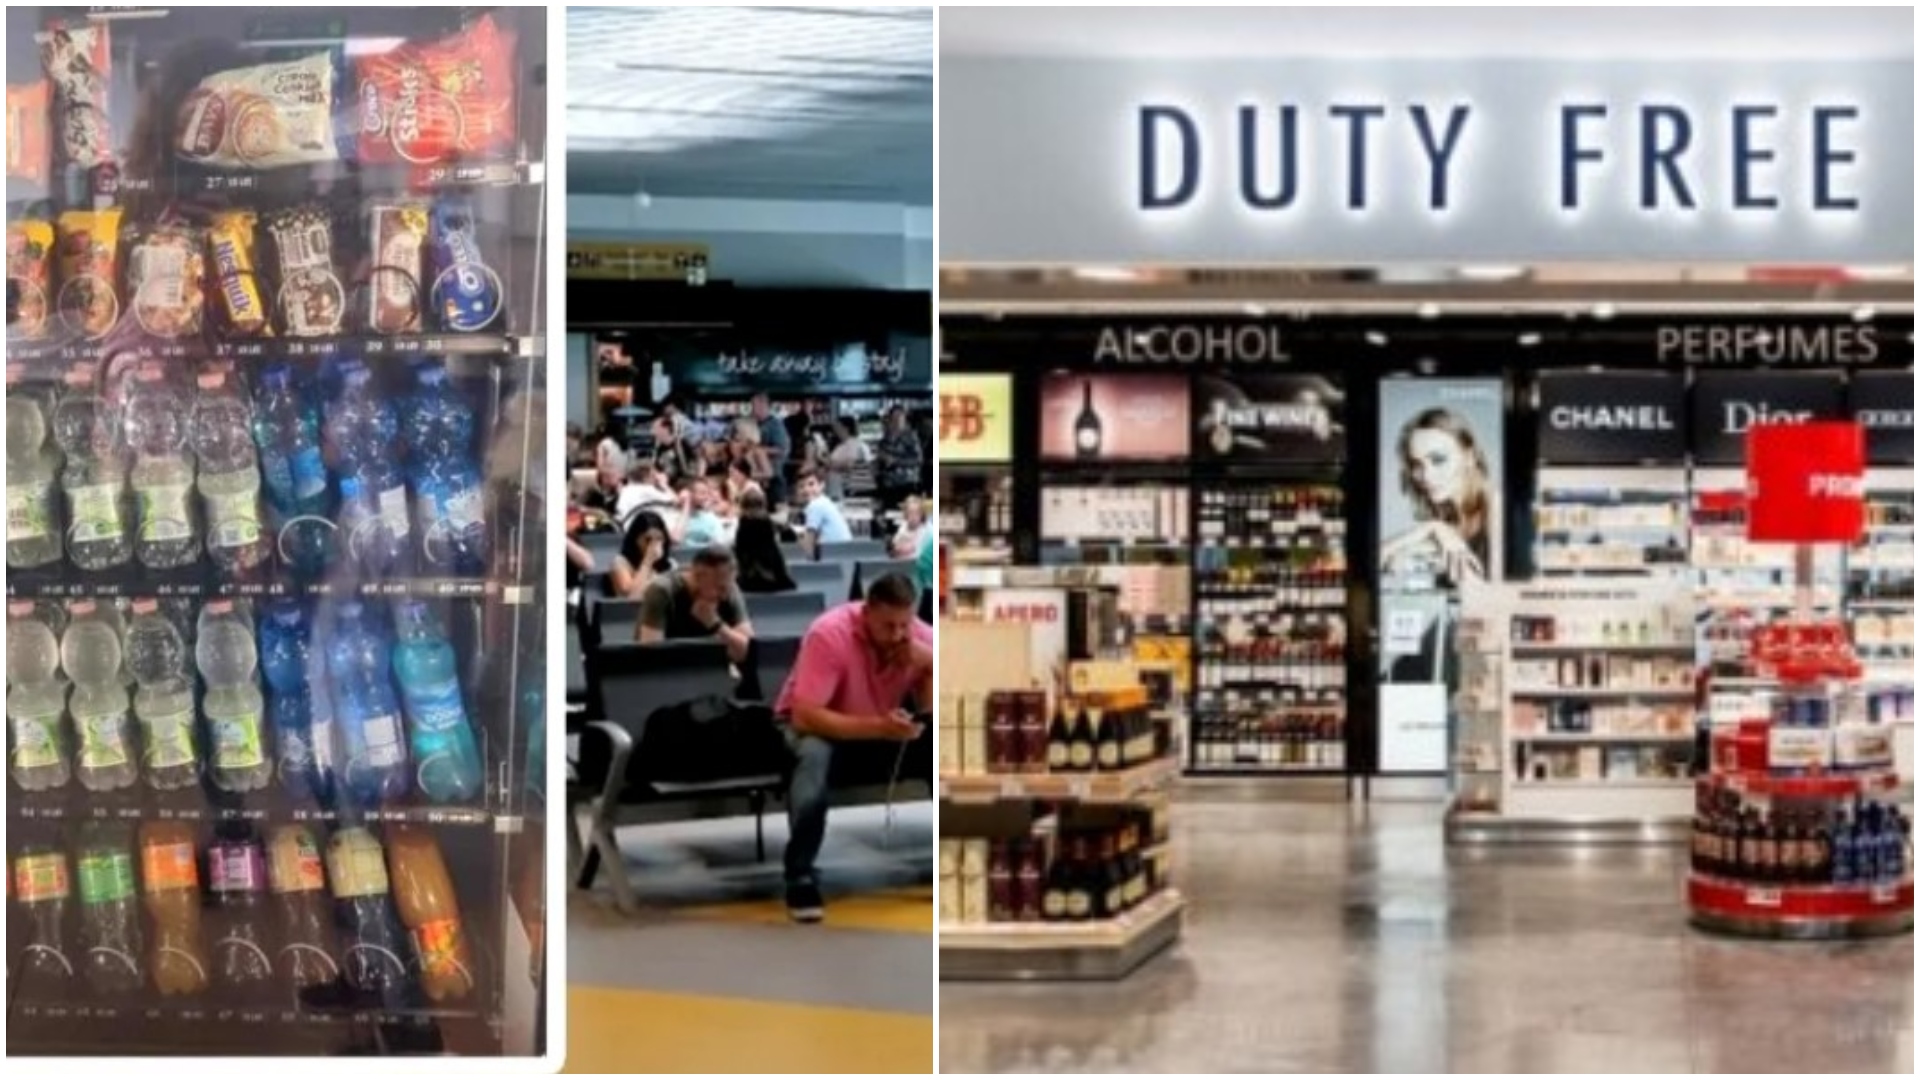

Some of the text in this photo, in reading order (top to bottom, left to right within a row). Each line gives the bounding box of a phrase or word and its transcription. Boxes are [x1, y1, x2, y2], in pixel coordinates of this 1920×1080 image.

[1137, 104, 1859, 211] DUTY FREE
[217, 240, 251, 316] Nesquik
[1094, 325, 1291, 362] ALCOHOL
[1657, 326, 1879, 363] PERFUMES
[717, 348, 767, 374] take
[769, 354, 827, 384] away
[1549, 404, 1675, 430] CHANEL
